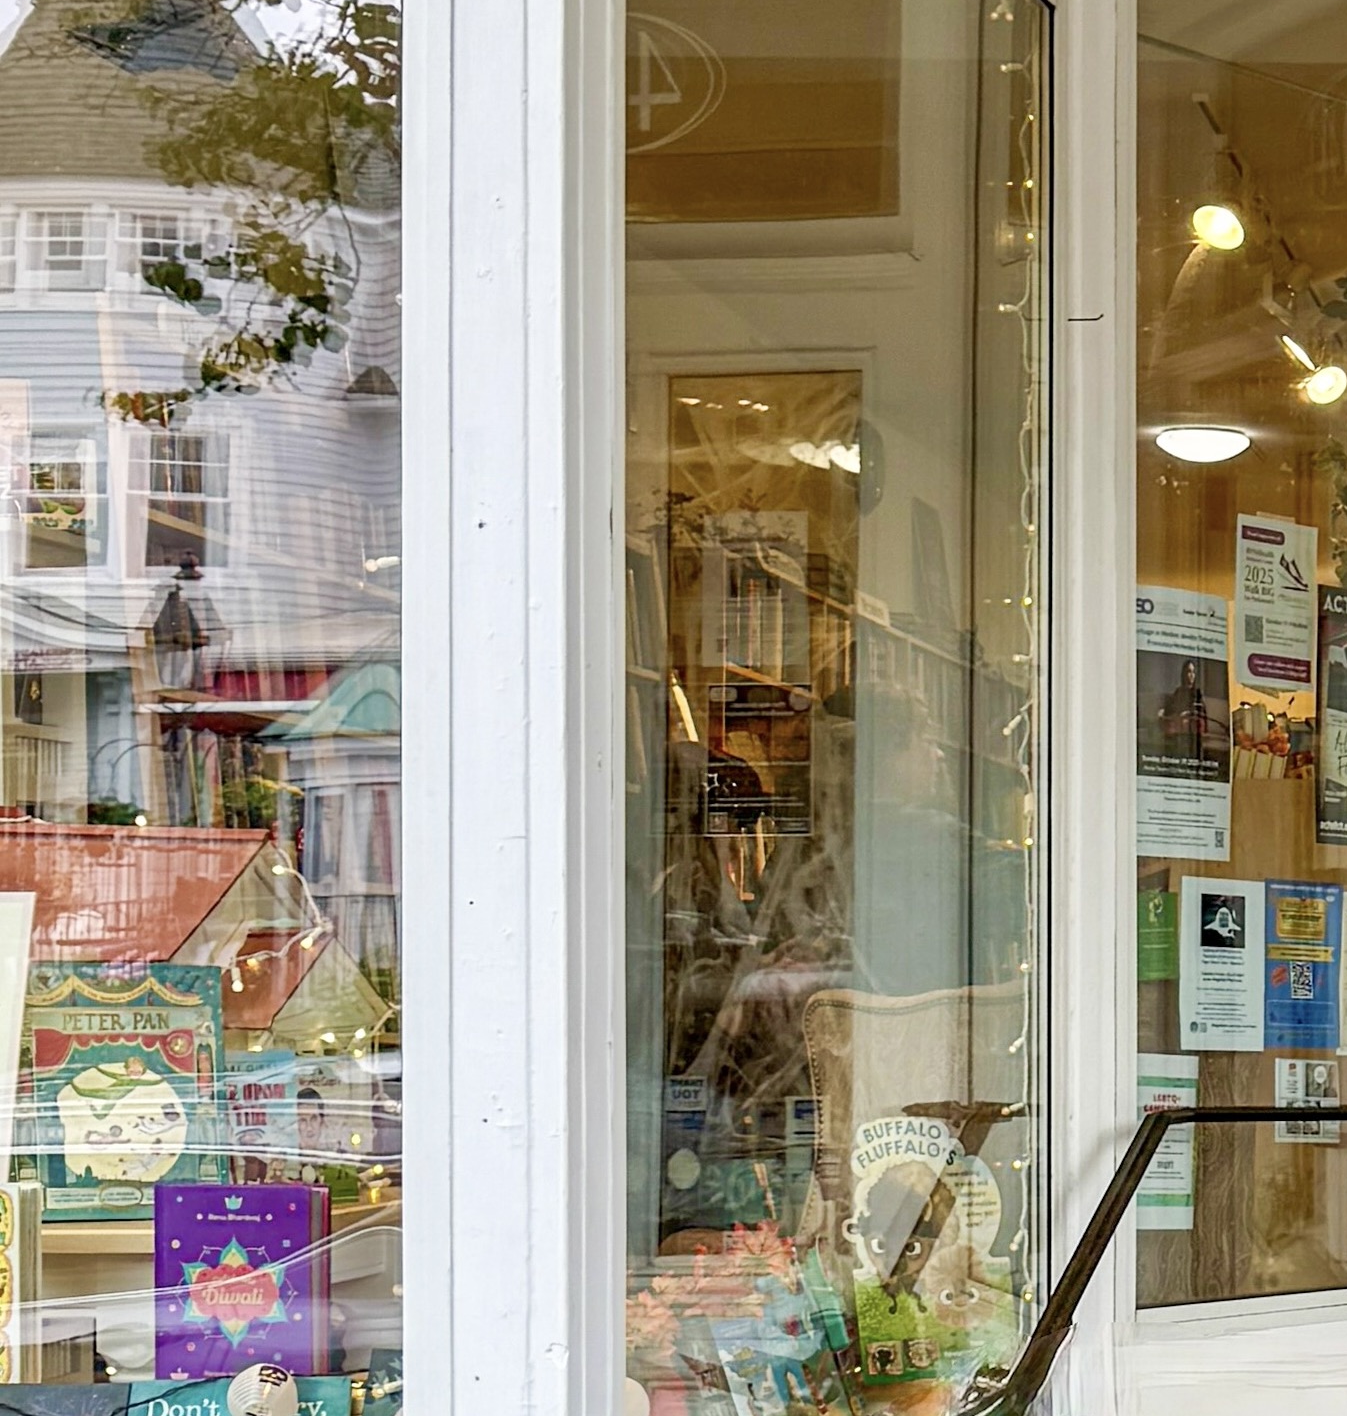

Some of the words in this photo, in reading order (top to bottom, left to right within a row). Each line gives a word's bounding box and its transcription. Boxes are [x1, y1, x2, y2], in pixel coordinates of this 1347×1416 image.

[1243, 564, 1275, 585] 2025
[62, 1011, 127, 1032] PETER
[132, 1009, 172, 1030] PAN
[862, 1119, 943, 1144] BUFFALO
[200, 1287, 267, 1306] Diwali
